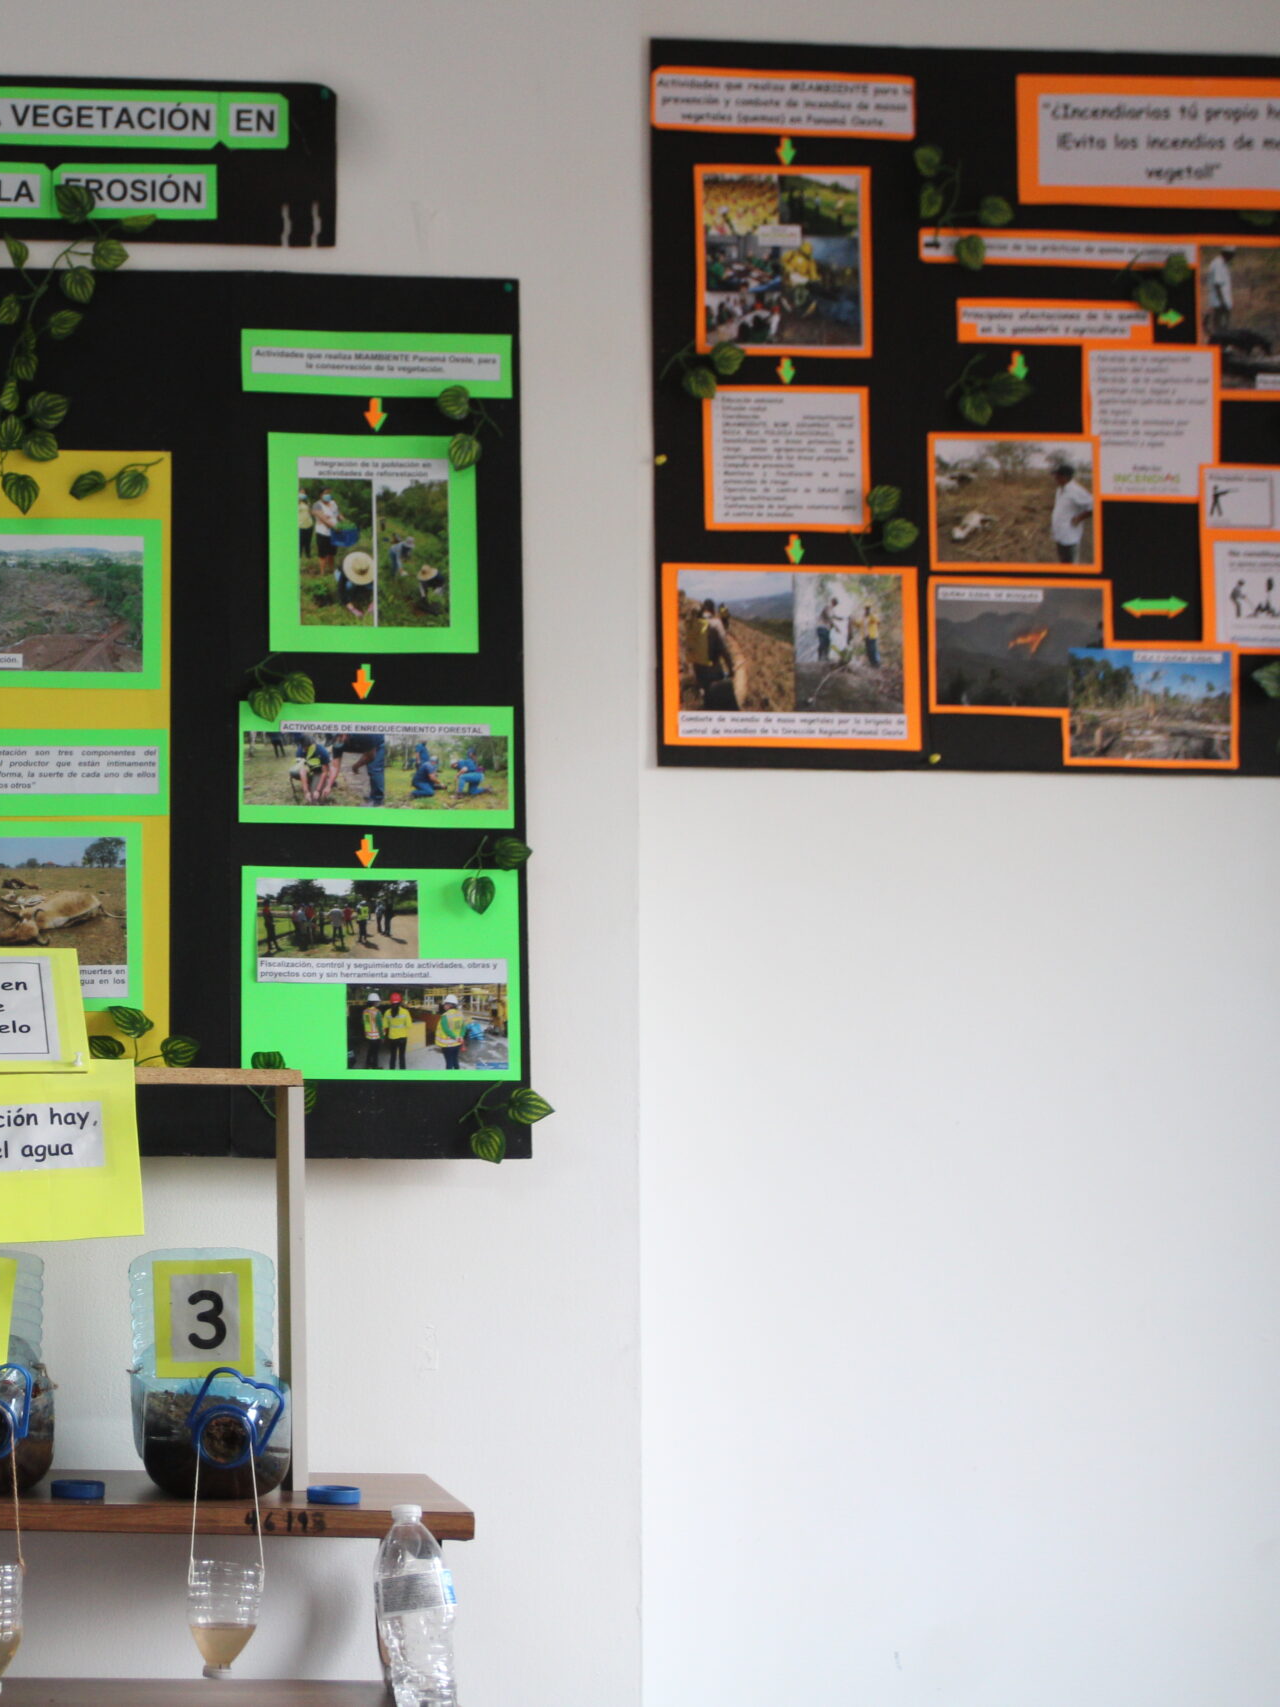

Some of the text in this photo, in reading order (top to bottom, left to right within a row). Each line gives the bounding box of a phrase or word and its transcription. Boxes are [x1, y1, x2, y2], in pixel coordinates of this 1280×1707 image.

[11, 102, 211, 131] VEGETACIÓN
[235, 109, 275, 132] EN
[282, 723, 339, 732] ACTIVIDADES
[340, 724, 352, 732] DE
[437, 726, 483, 734] FORESTAL
[316, 961, 344, 969] control
[346, 963, 352, 971] y
[354, 961, 404, 971] seguimiento
[405, 961, 415, 969] de
[492, 963, 498, 971] y
[260, 970, 300, 979] proyectos
[326, 970, 338, 979] sin
[340, 970, 388, 979] herramienta
[0, 981, 27, 991] en
[49, 1106, 97, 1130] hay,
[20, 1143, 73, 1163] agua
[188, 1290, 227, 1350] 3
